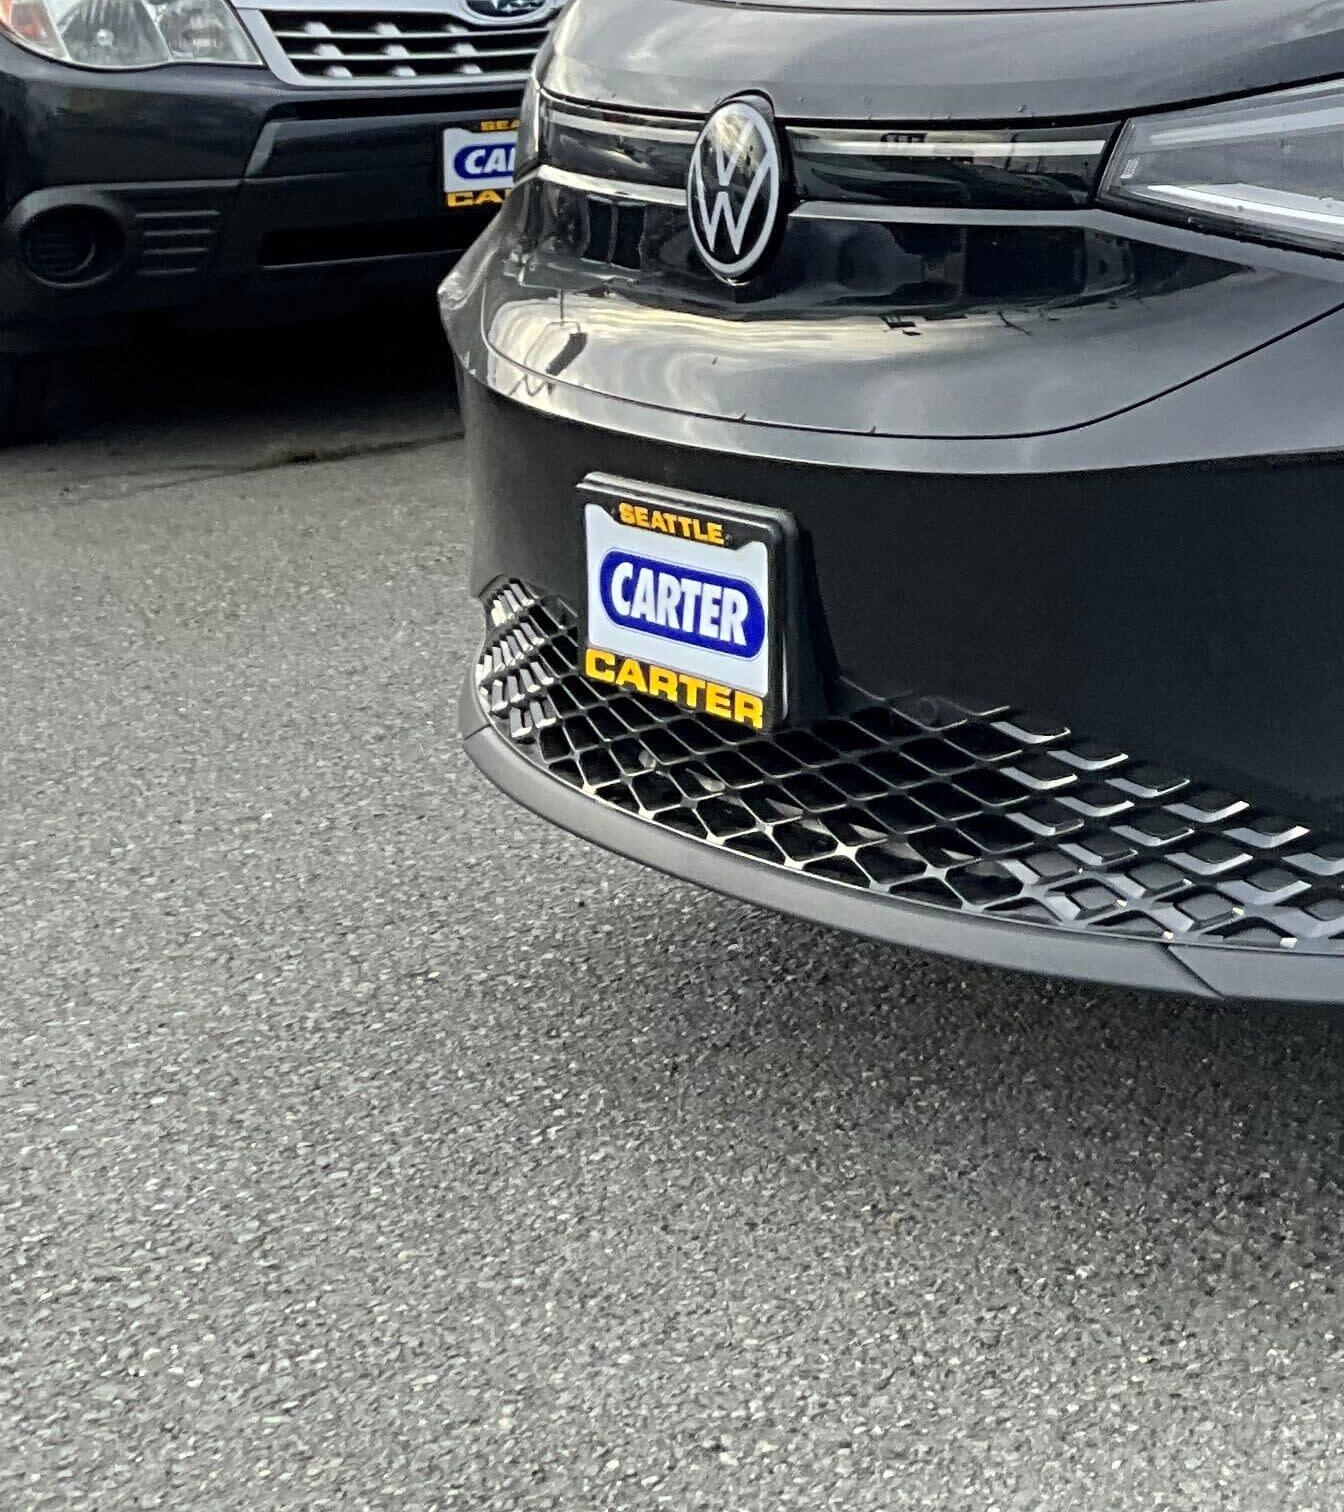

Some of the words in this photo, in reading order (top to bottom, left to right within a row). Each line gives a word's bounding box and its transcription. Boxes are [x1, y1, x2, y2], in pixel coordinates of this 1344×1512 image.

[448, 189, 512, 207] CA
[618, 502, 725, 545] SEATTLE
[611, 562, 749, 646] CARTER
[585, 648, 763, 729] CARTER
